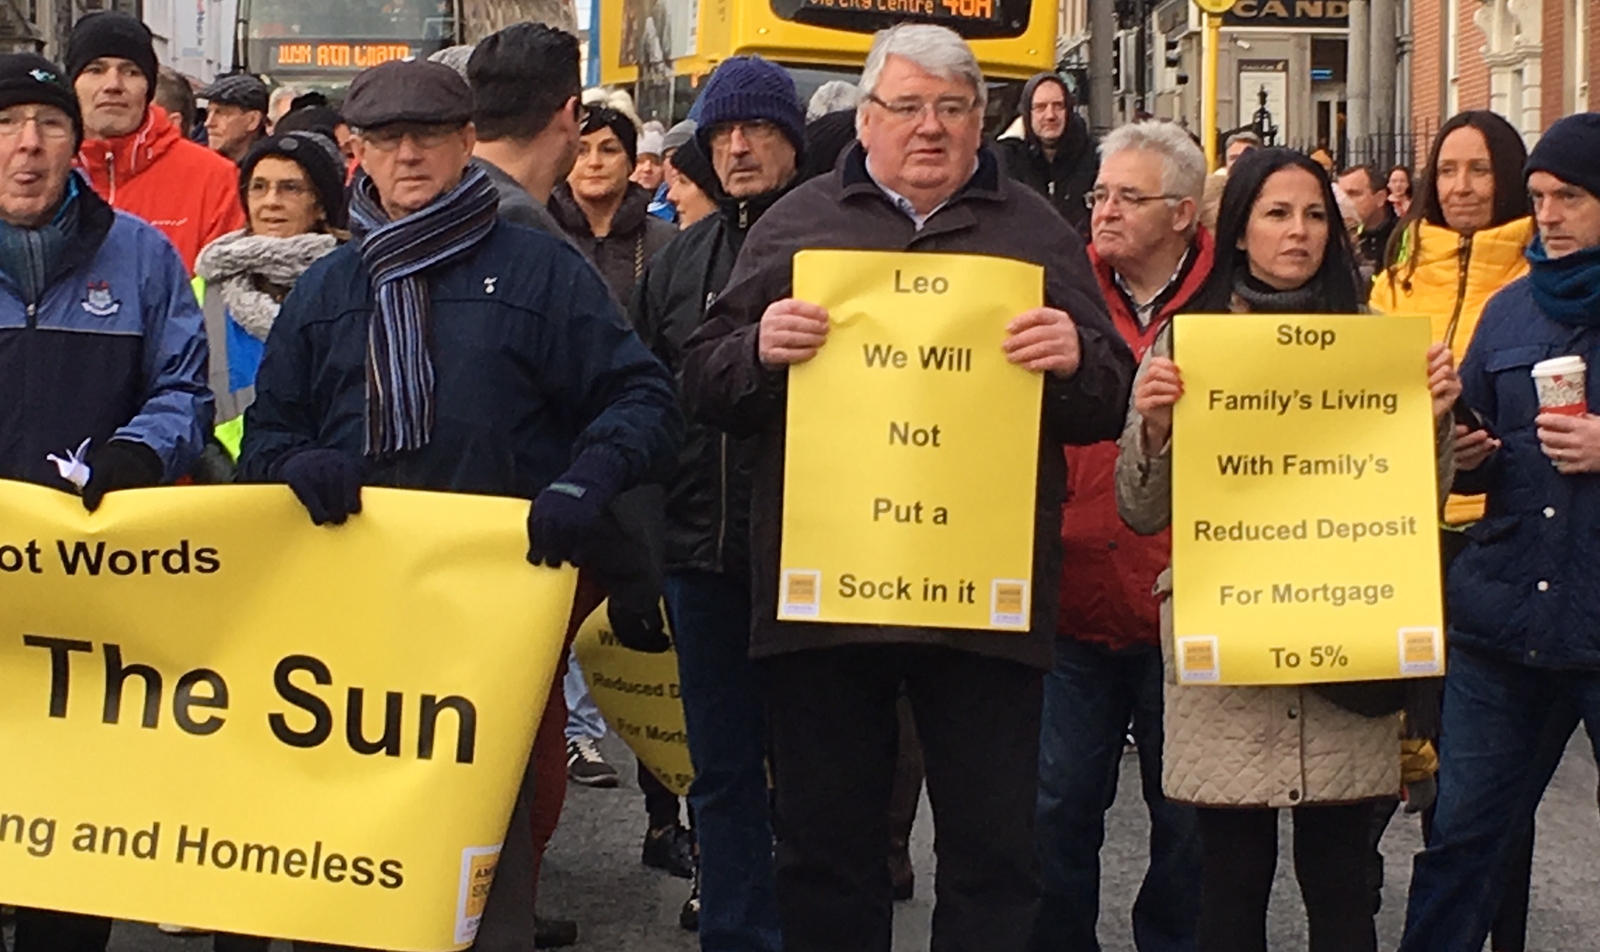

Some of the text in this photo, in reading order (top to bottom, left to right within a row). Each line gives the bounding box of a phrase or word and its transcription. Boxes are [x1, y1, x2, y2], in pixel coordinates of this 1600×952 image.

[894, 269, 949, 295] Leo
[1276, 323, 1336, 350] Stop
[863, 343, 972, 372] We Will
[1208, 388, 1399, 416] Family’s Living
[888, 421, 941, 448] Not
[1217, 453, 1389, 480] With Family’s
[872, 497, 949, 526] Put a
[1194, 516, 1417, 542] Reduced Deposit
[57, 540, 221, 576] Words
[838, 573, 912, 601] Sock
[922, 577, 948, 604] in
[957, 579, 976, 605] it
[1220, 582, 1395, 607] For Mortgage
[1269, 645, 1349, 669] To 5%
[592, 672, 664, 697] Reduced
[23, 634, 478, 765] The Sun
[616, 717, 642, 736] For
[72, 821, 161, 860] and
[175, 824, 405, 890] Homeless
